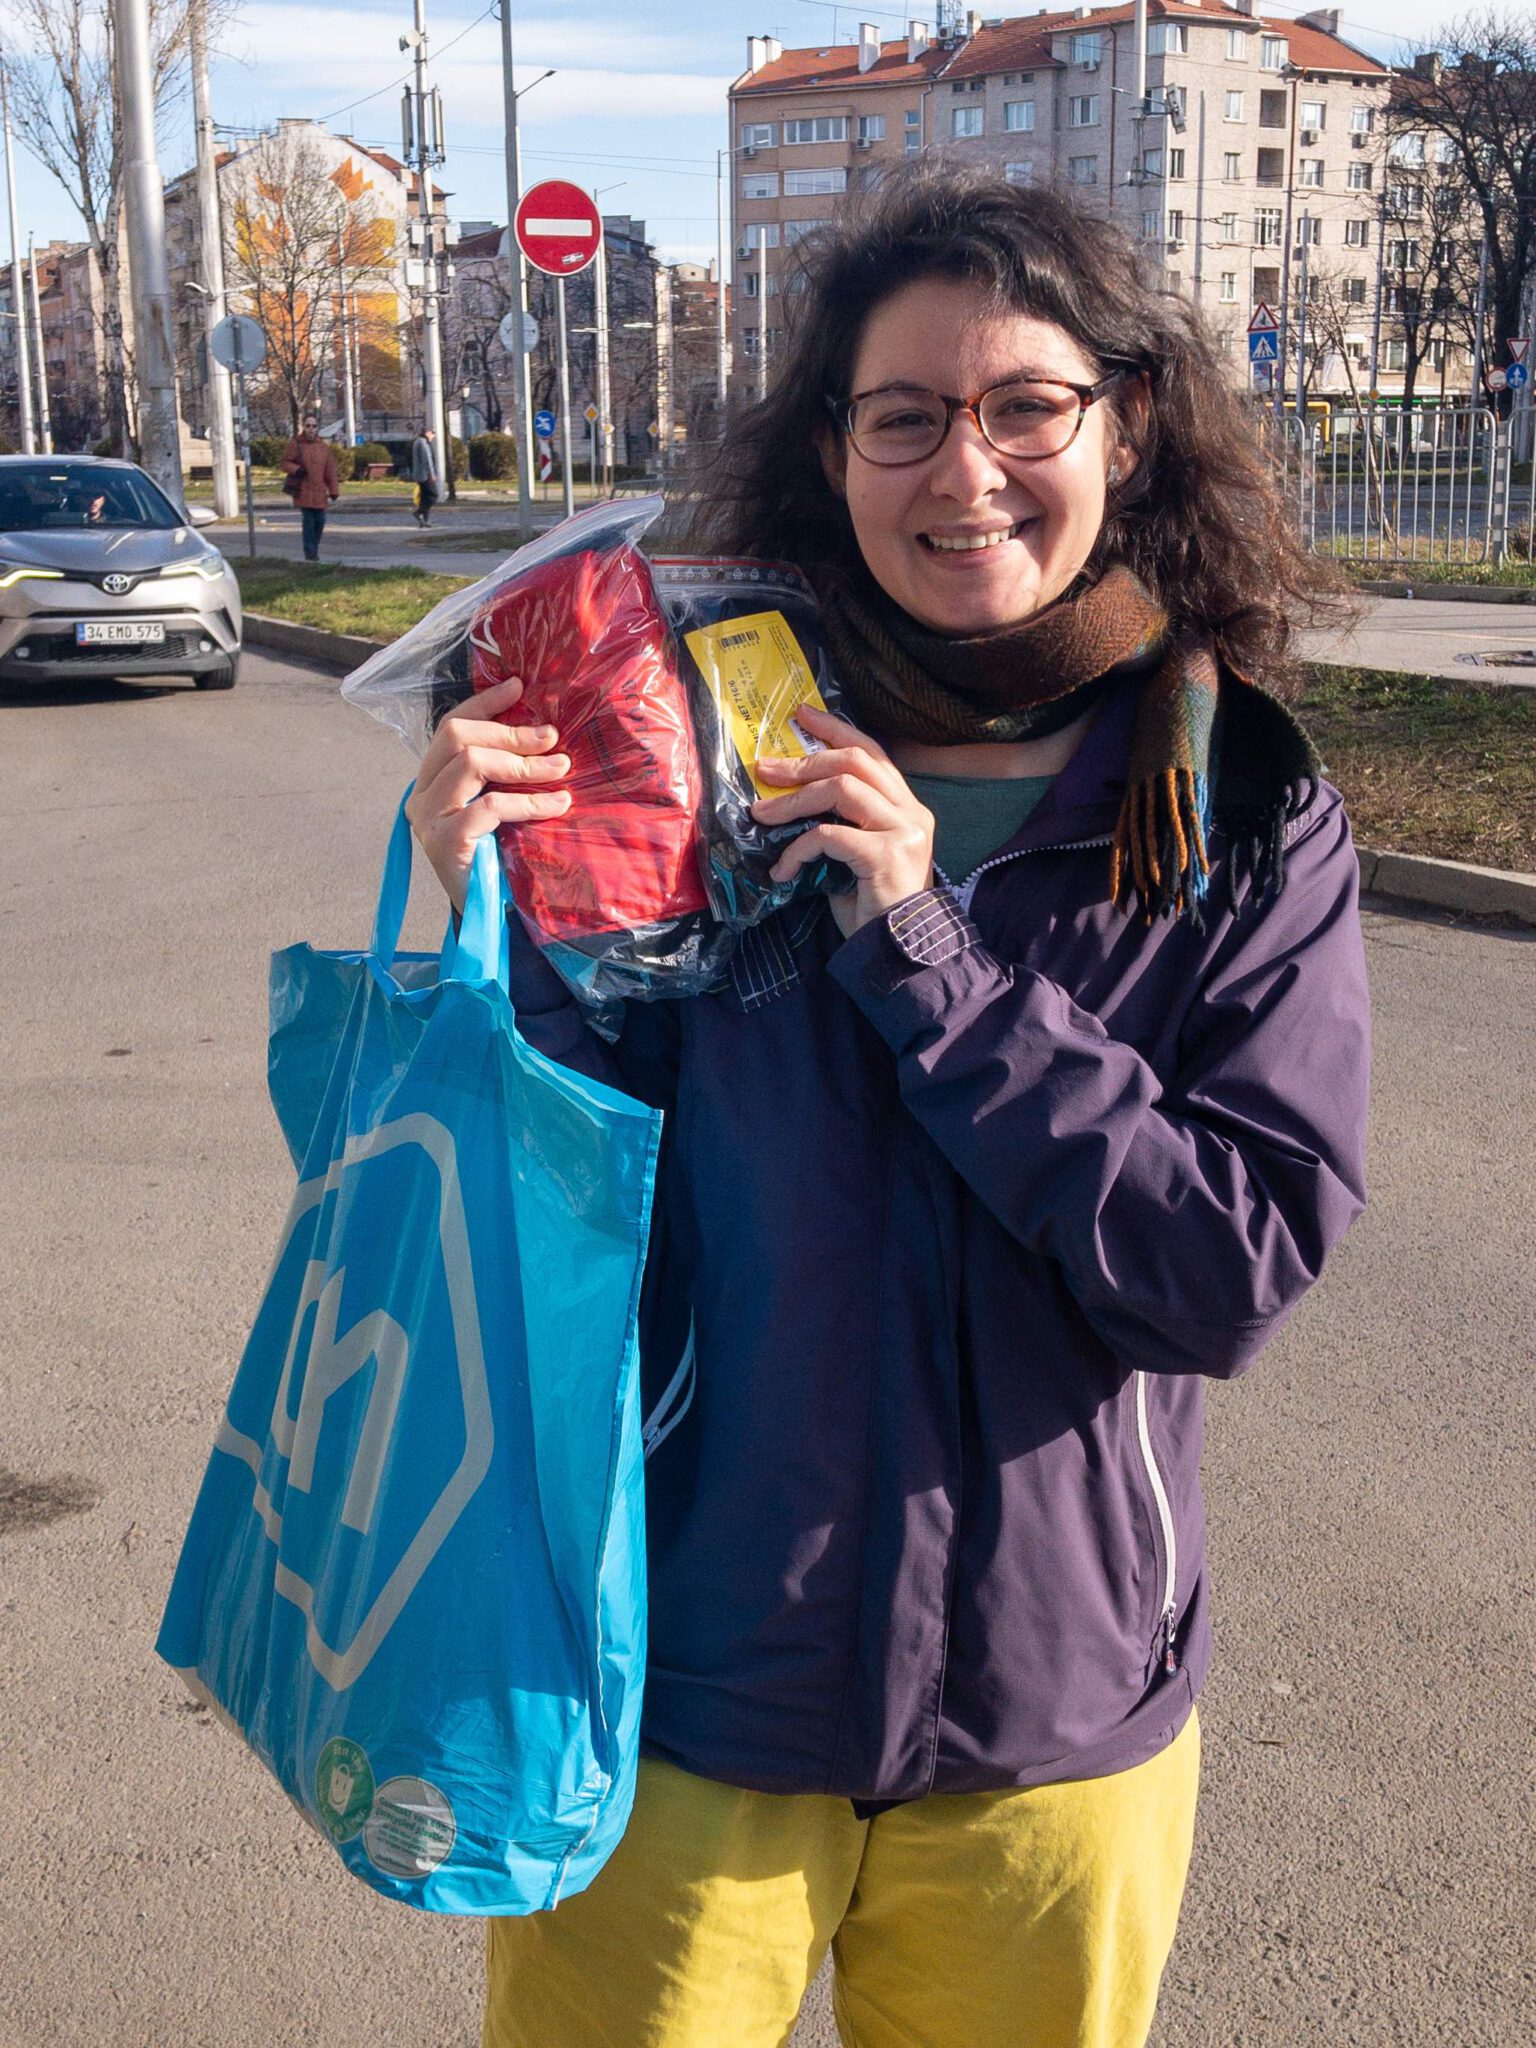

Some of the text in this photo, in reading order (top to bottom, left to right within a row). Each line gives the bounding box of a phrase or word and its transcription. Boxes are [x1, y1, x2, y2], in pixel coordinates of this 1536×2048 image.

[87, 626, 103, 639] 34
[137, 625, 160, 638] 575
[737, 703, 751, 720] NET
